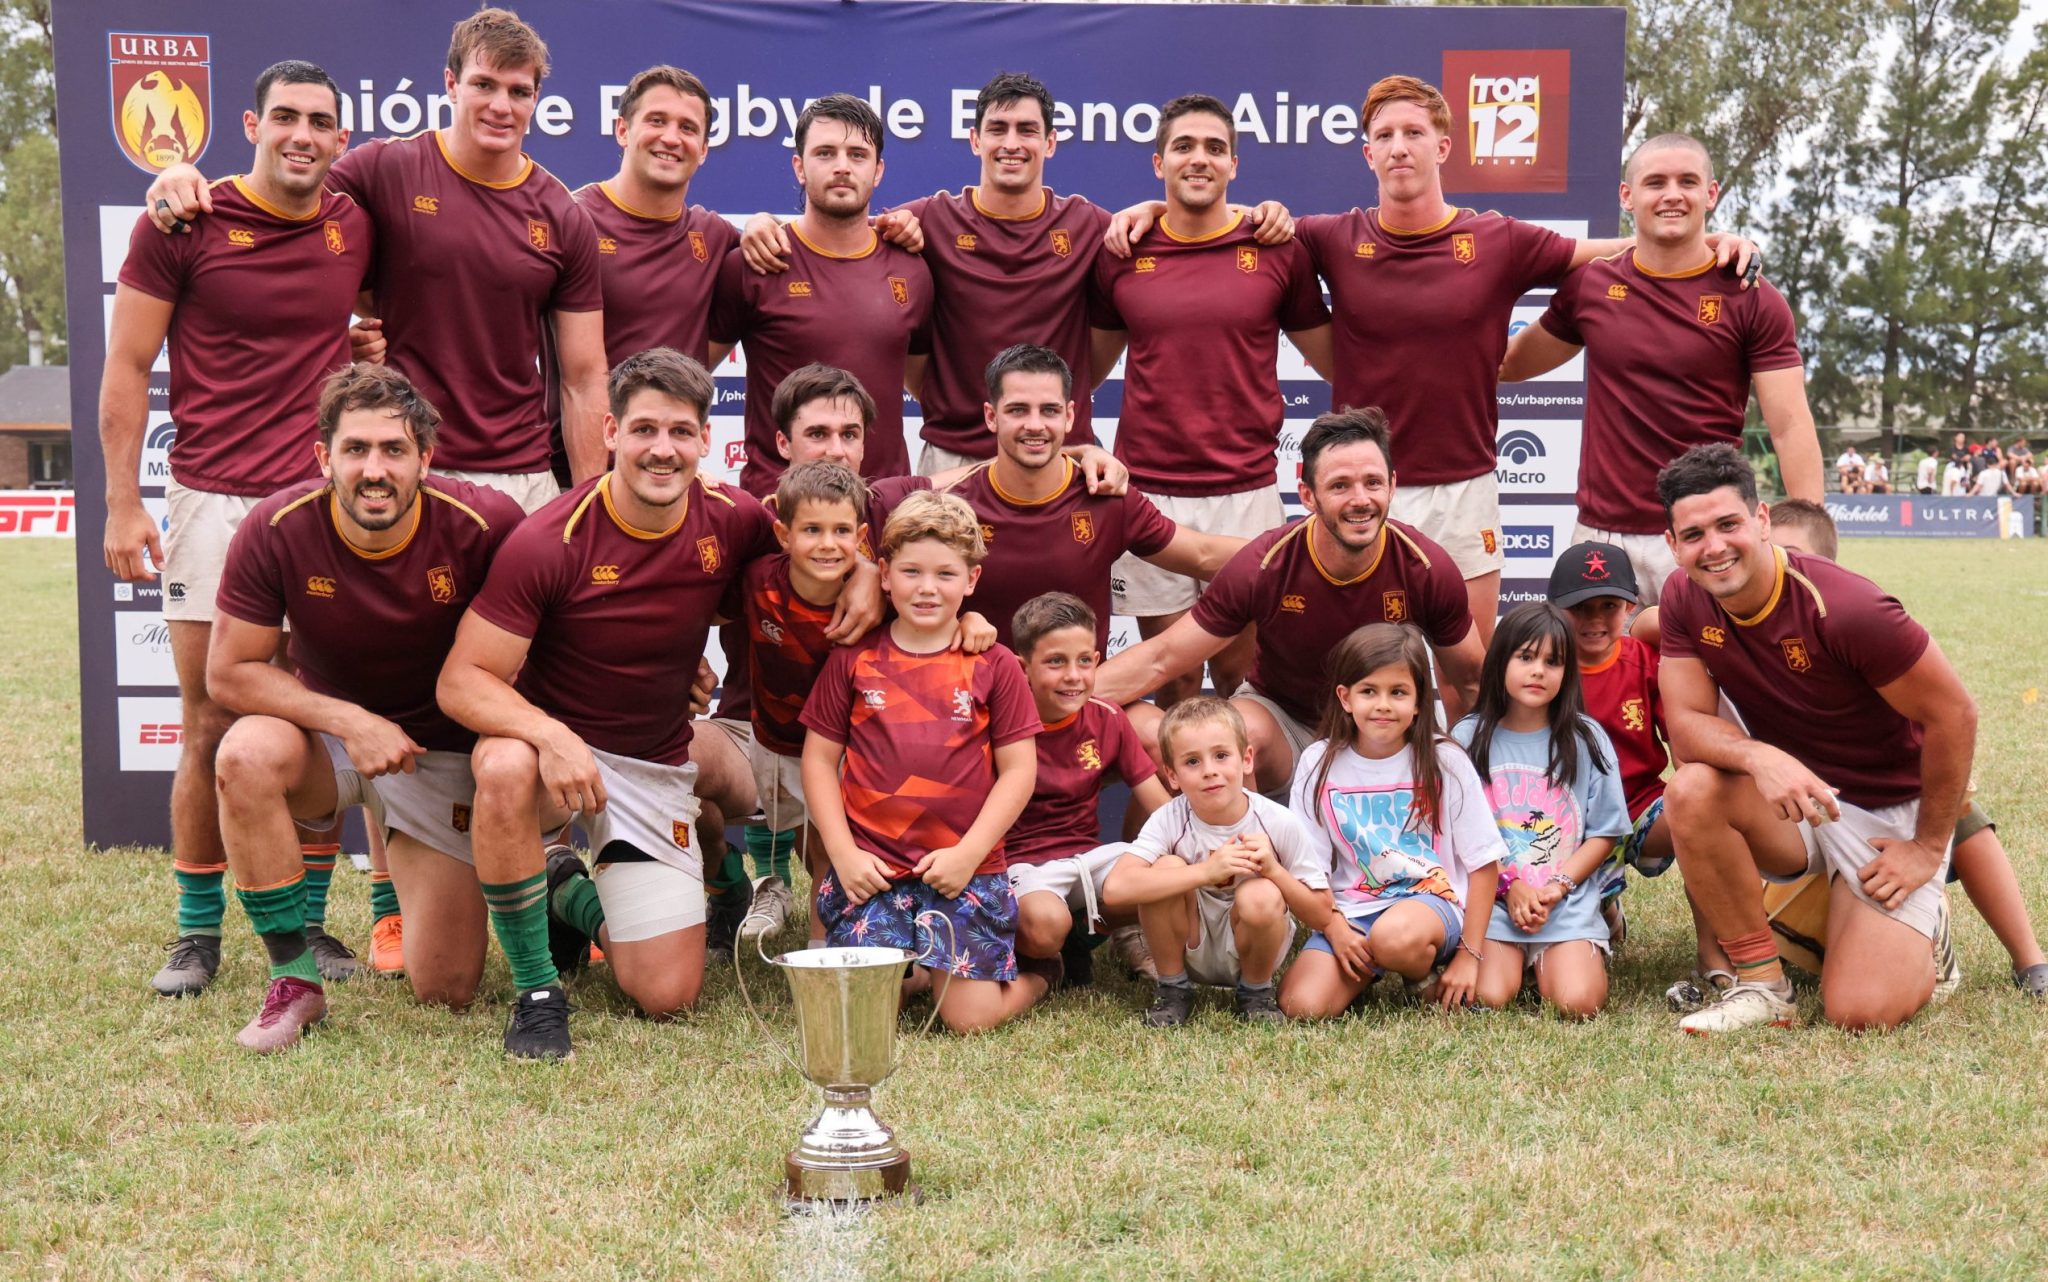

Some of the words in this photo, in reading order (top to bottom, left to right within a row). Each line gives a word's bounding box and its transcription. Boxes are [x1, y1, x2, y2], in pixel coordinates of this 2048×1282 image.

[119, 37, 199, 57] URBA
[1474, 77, 1537, 103] TOP
[1232, 91, 1366, 144] Aire
[1471, 105, 1538, 157] 12
[155, 154, 175, 162] 1899
[1494, 469, 1546, 484] Macro
[1922, 508, 1994, 521] ULTRA
[1503, 534, 1550, 550] DICUS
[1331, 791, 1413, 844] SURF
